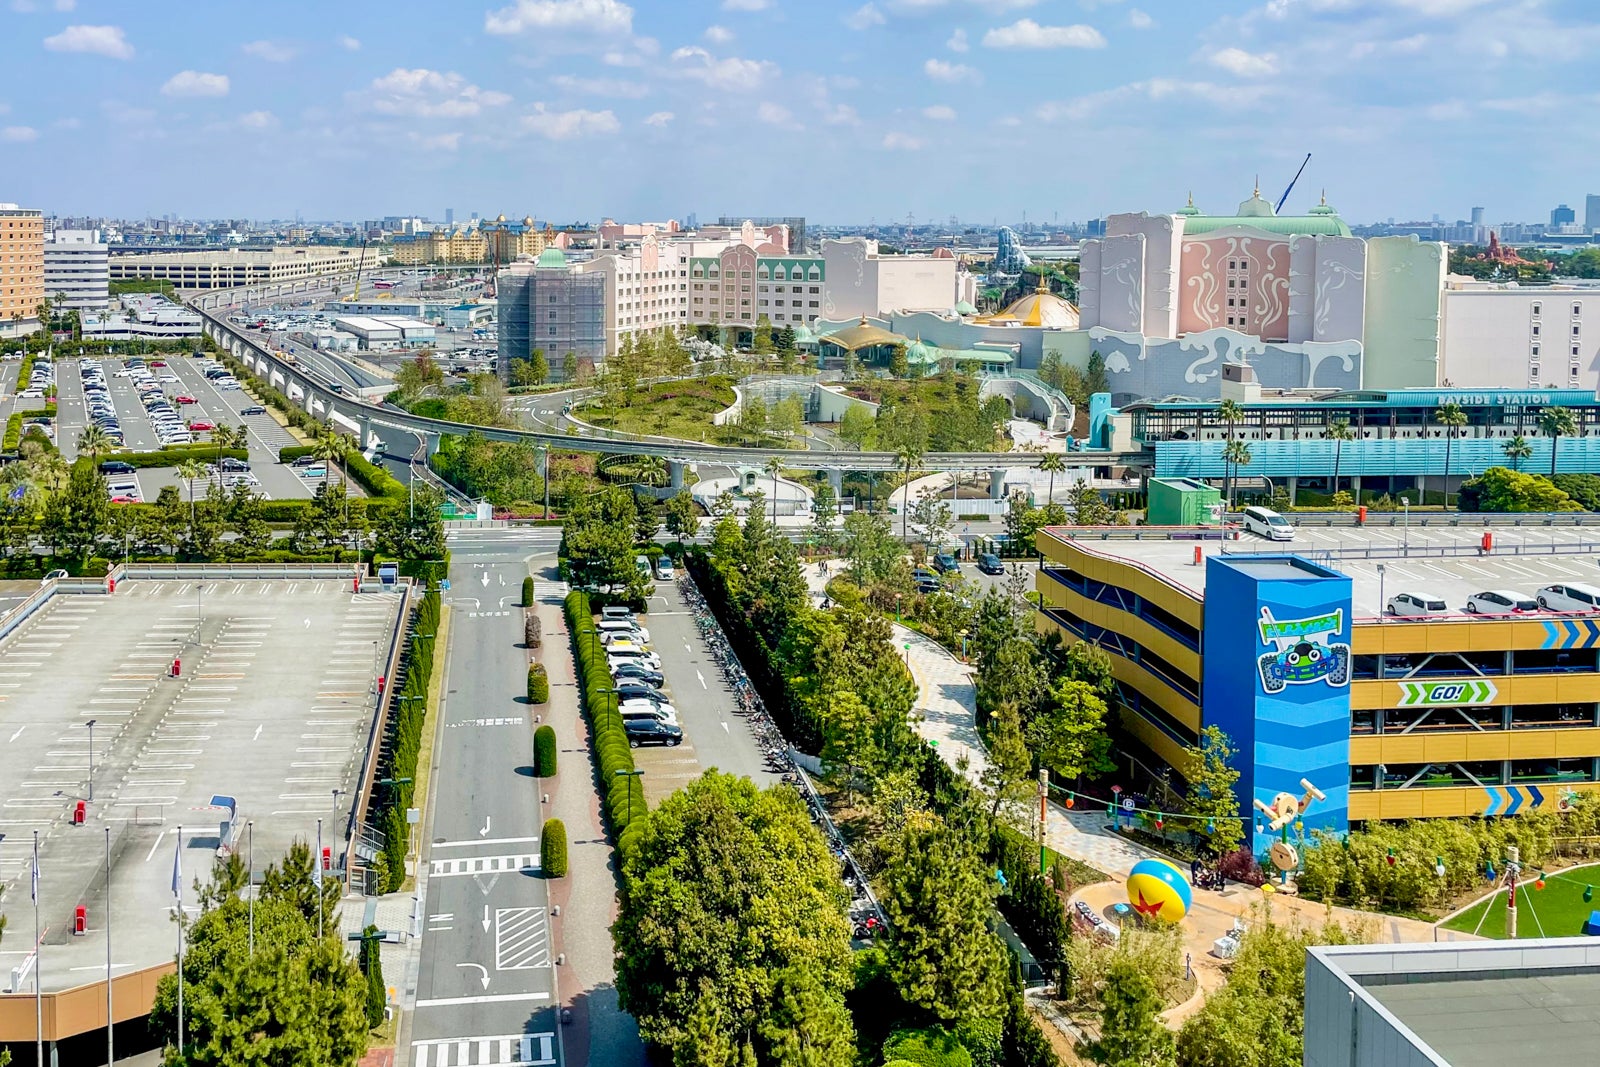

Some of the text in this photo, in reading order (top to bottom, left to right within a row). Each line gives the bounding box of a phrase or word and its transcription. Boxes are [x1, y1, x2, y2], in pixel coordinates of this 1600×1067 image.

[1438, 394, 1551, 405] BAYSIDE STATION
[1431, 686, 1463, 700] GO!
